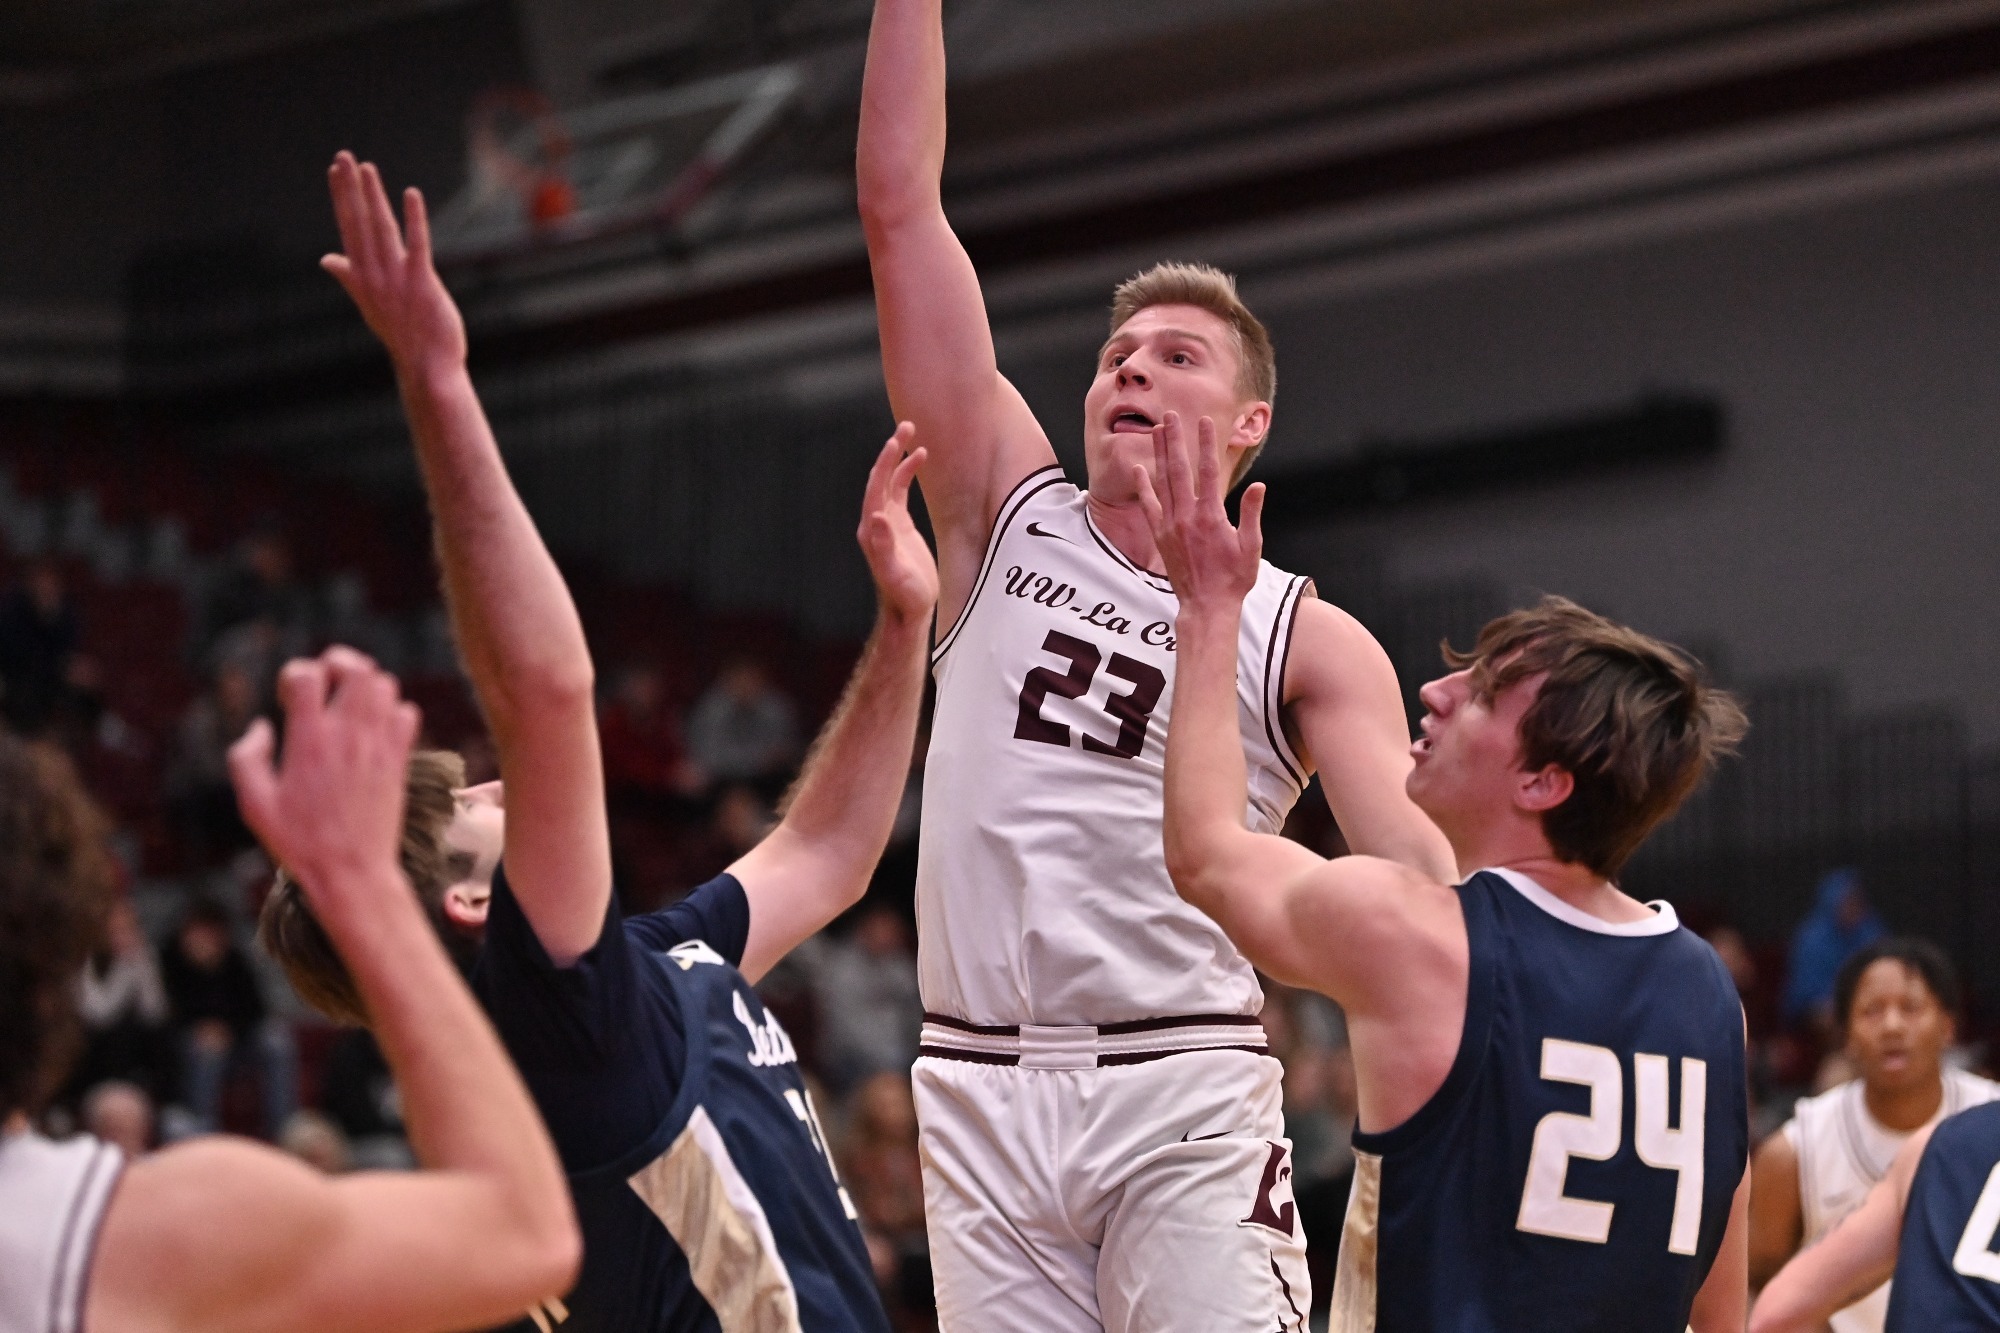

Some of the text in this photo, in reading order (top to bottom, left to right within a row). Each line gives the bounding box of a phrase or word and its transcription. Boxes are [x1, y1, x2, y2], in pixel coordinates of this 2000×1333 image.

[1005, 565, 1132, 635] UW-La
[1013, 628, 1167, 760] 23
[1516, 1037, 1707, 1257] 24
